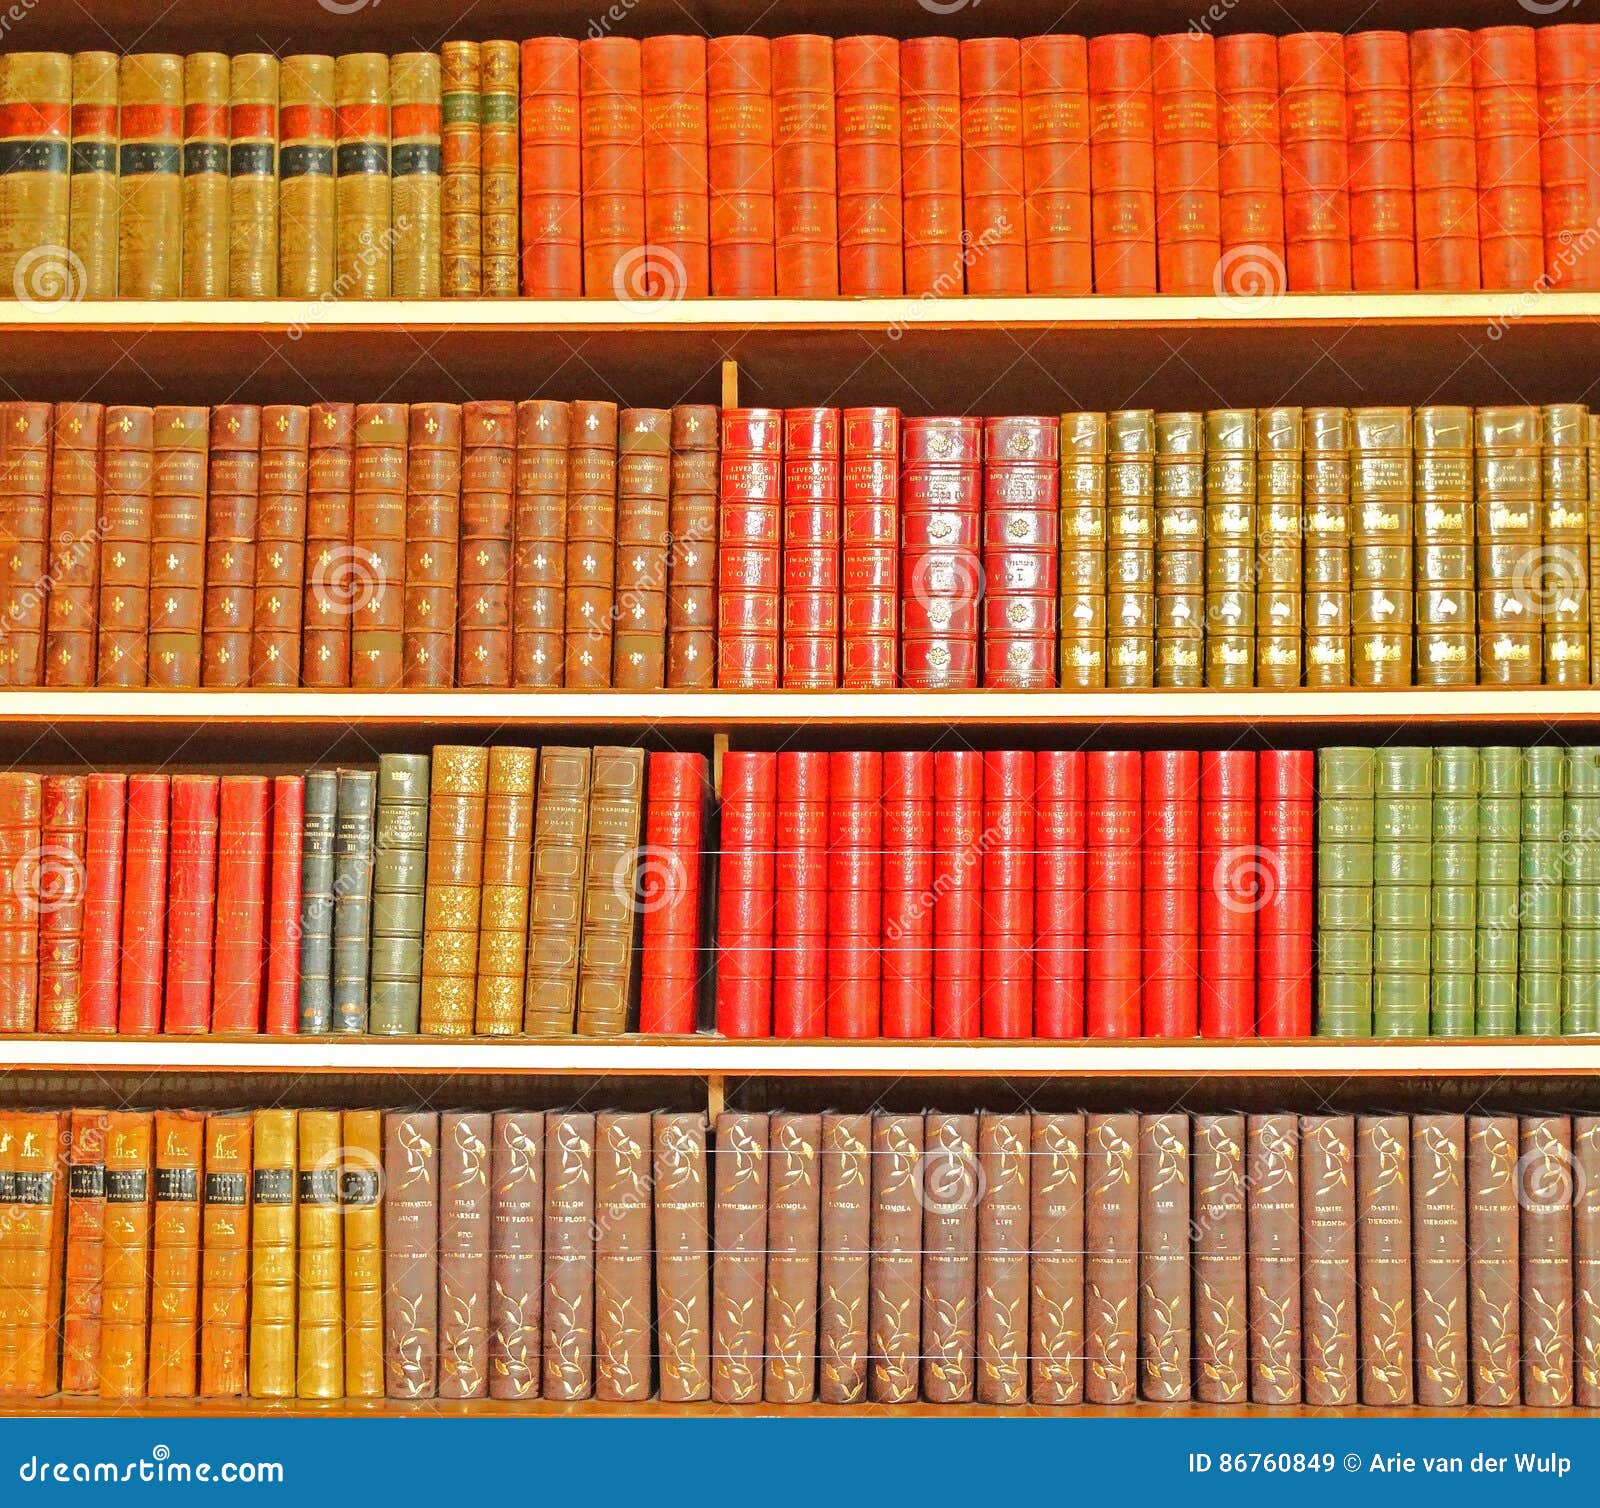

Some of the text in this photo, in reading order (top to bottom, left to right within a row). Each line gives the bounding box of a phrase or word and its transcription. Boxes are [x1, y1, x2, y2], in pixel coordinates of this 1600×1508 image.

[519, 1201, 532, 1209] ON
[1048, 1204, 1067, 1212] LIFE
[1102, 1203, 1120, 1211] LIFE
[1200, 1203, 1223, 1211] ADAM
[1315, 1205, 1344, 1213] DANIEL
[1371, 1204, 1400, 1212] DANIEL
